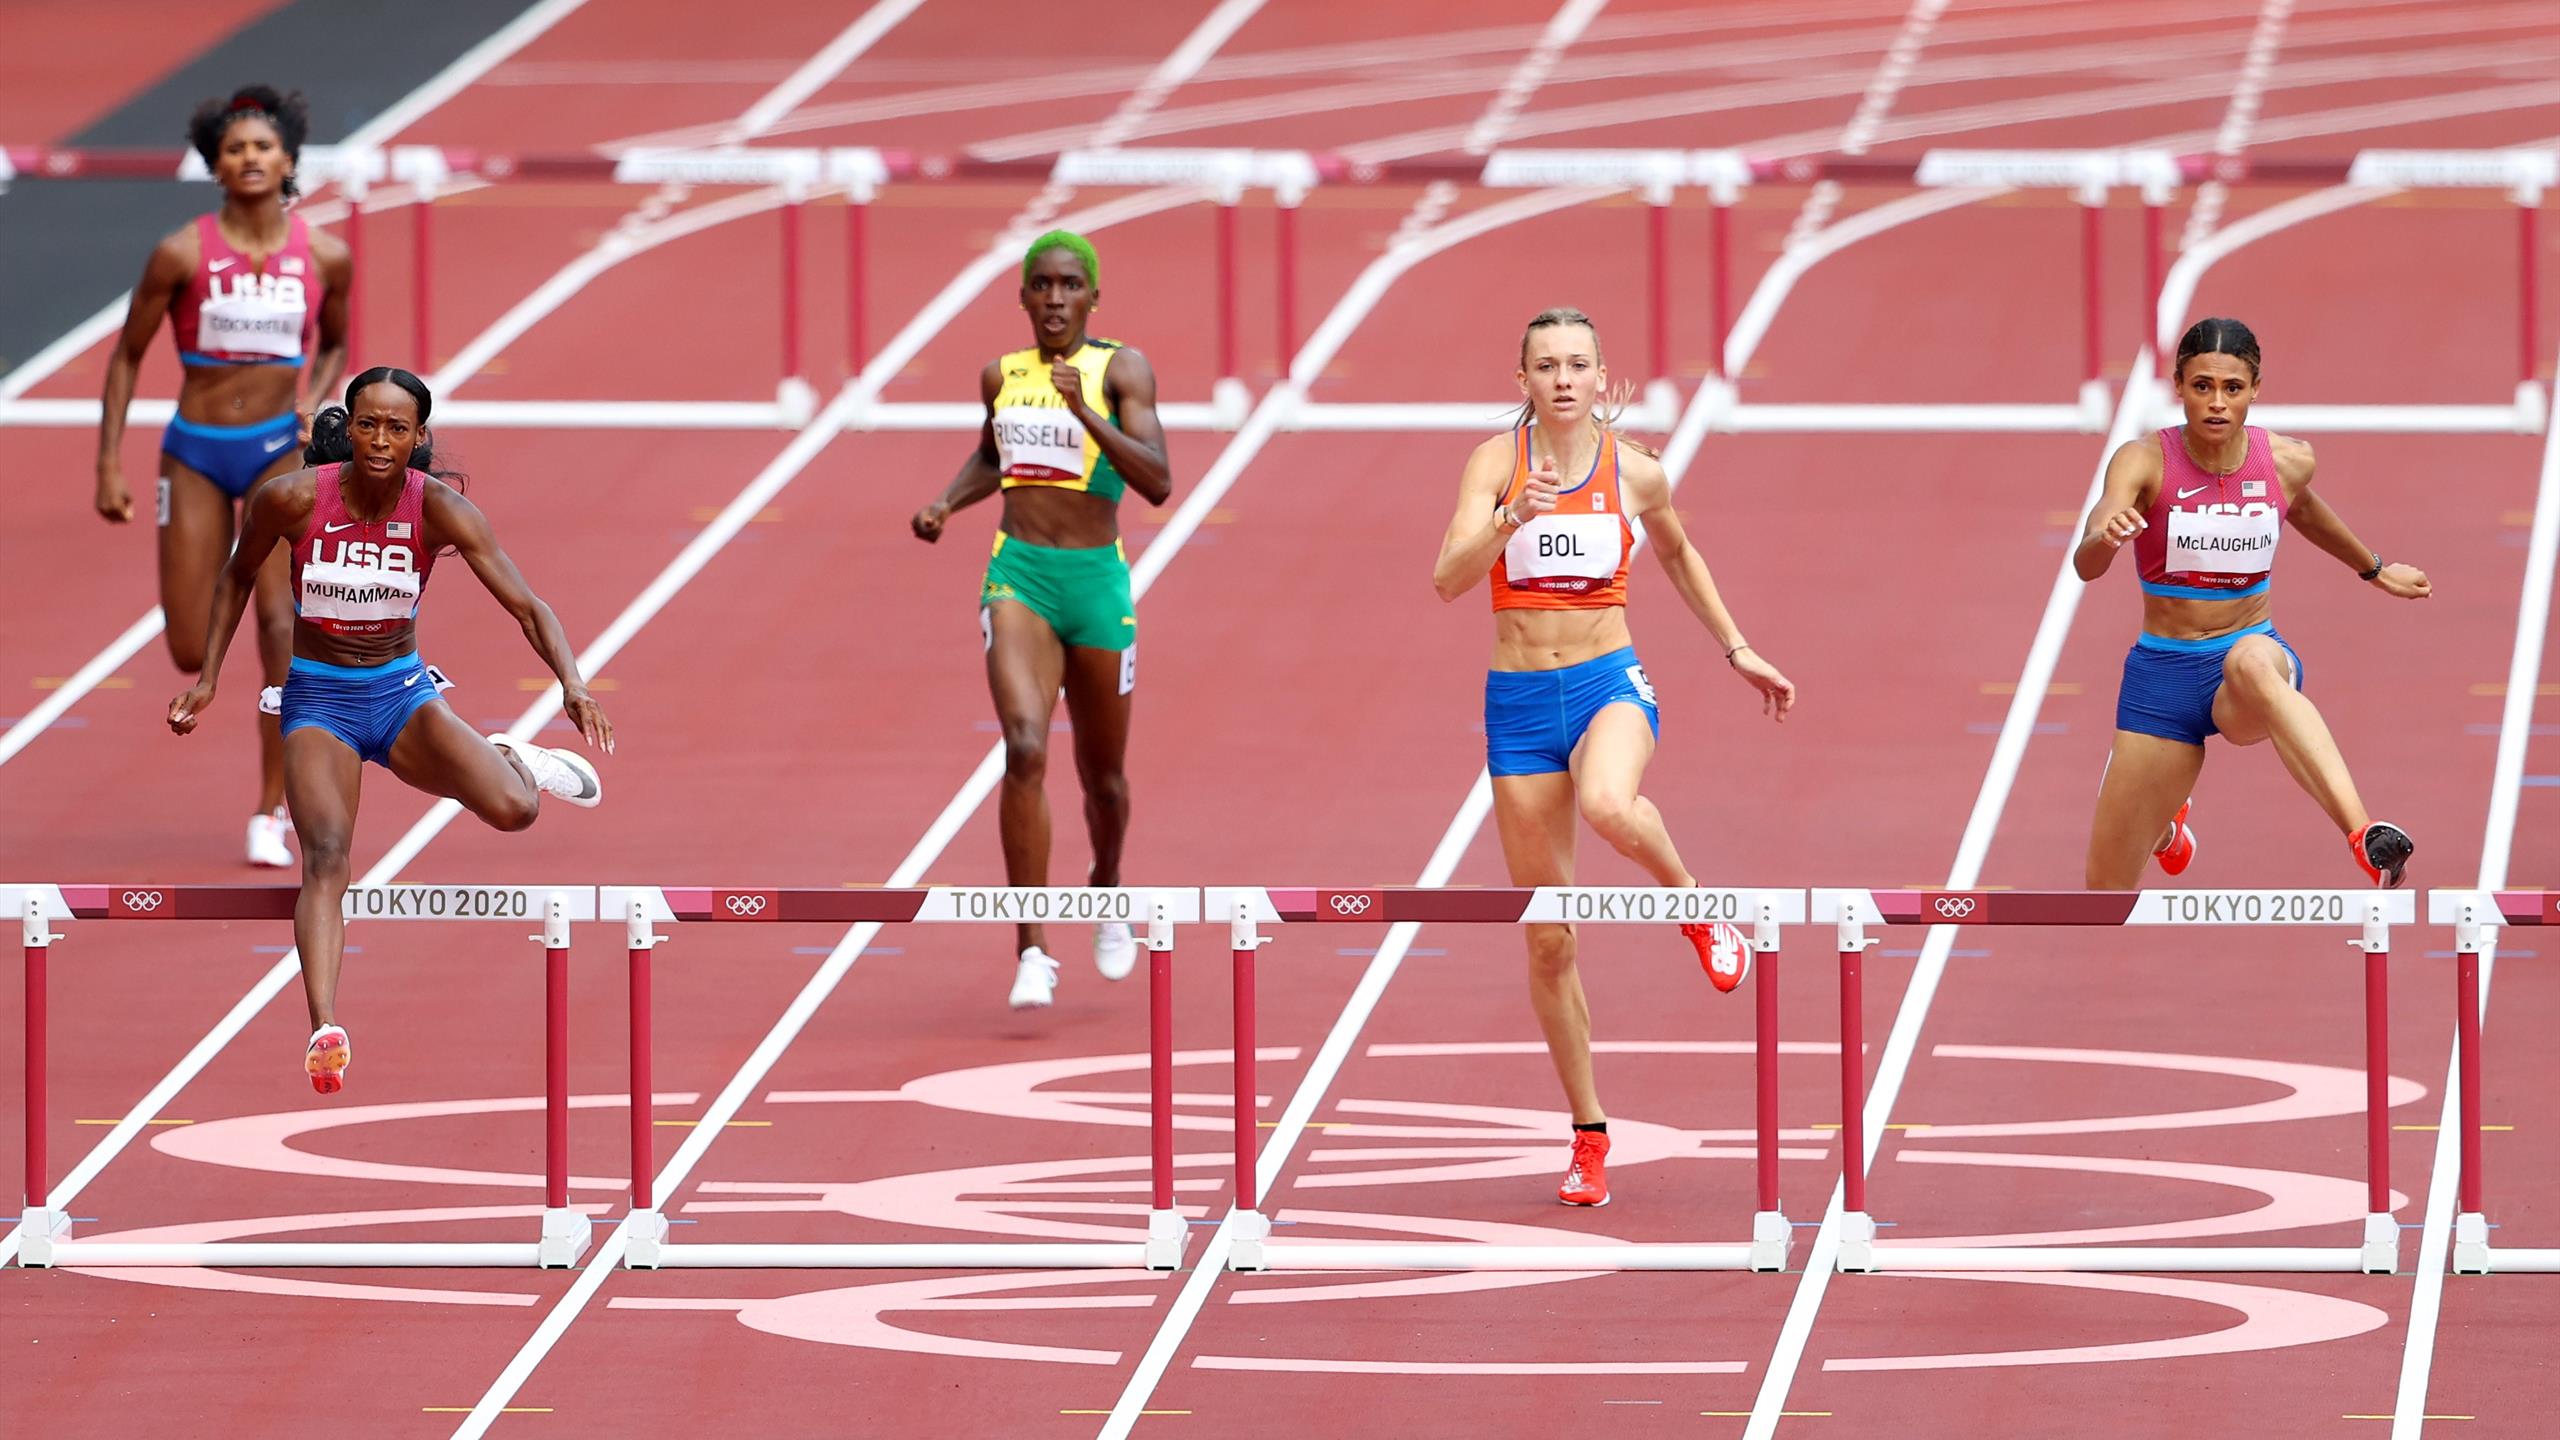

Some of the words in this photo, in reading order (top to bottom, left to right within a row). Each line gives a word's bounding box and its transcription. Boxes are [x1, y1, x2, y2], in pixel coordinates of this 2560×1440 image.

[994, 423, 1079, 449] RUSSELL
[1539, 534, 1585, 557] BOL
[2177, 533, 2272, 552] McLAUGHLIN
[312, 538, 414, 575] USA
[306, 583, 413, 603] MUHAMMAD
[332, 623, 350, 631] TOKYO
[348, 889, 446, 916] TOKYO
[455, 890, 527, 917] 2020
[949, 893, 1049, 919] TOKYO
[1059, 893, 1131, 919] 2020
[1556, 893, 1656, 919] TOKYO
[1666, 893, 1738, 919] 2020
[2162, 894, 2262, 921] TOKYO
[2270, 894, 2344, 921] 2020
